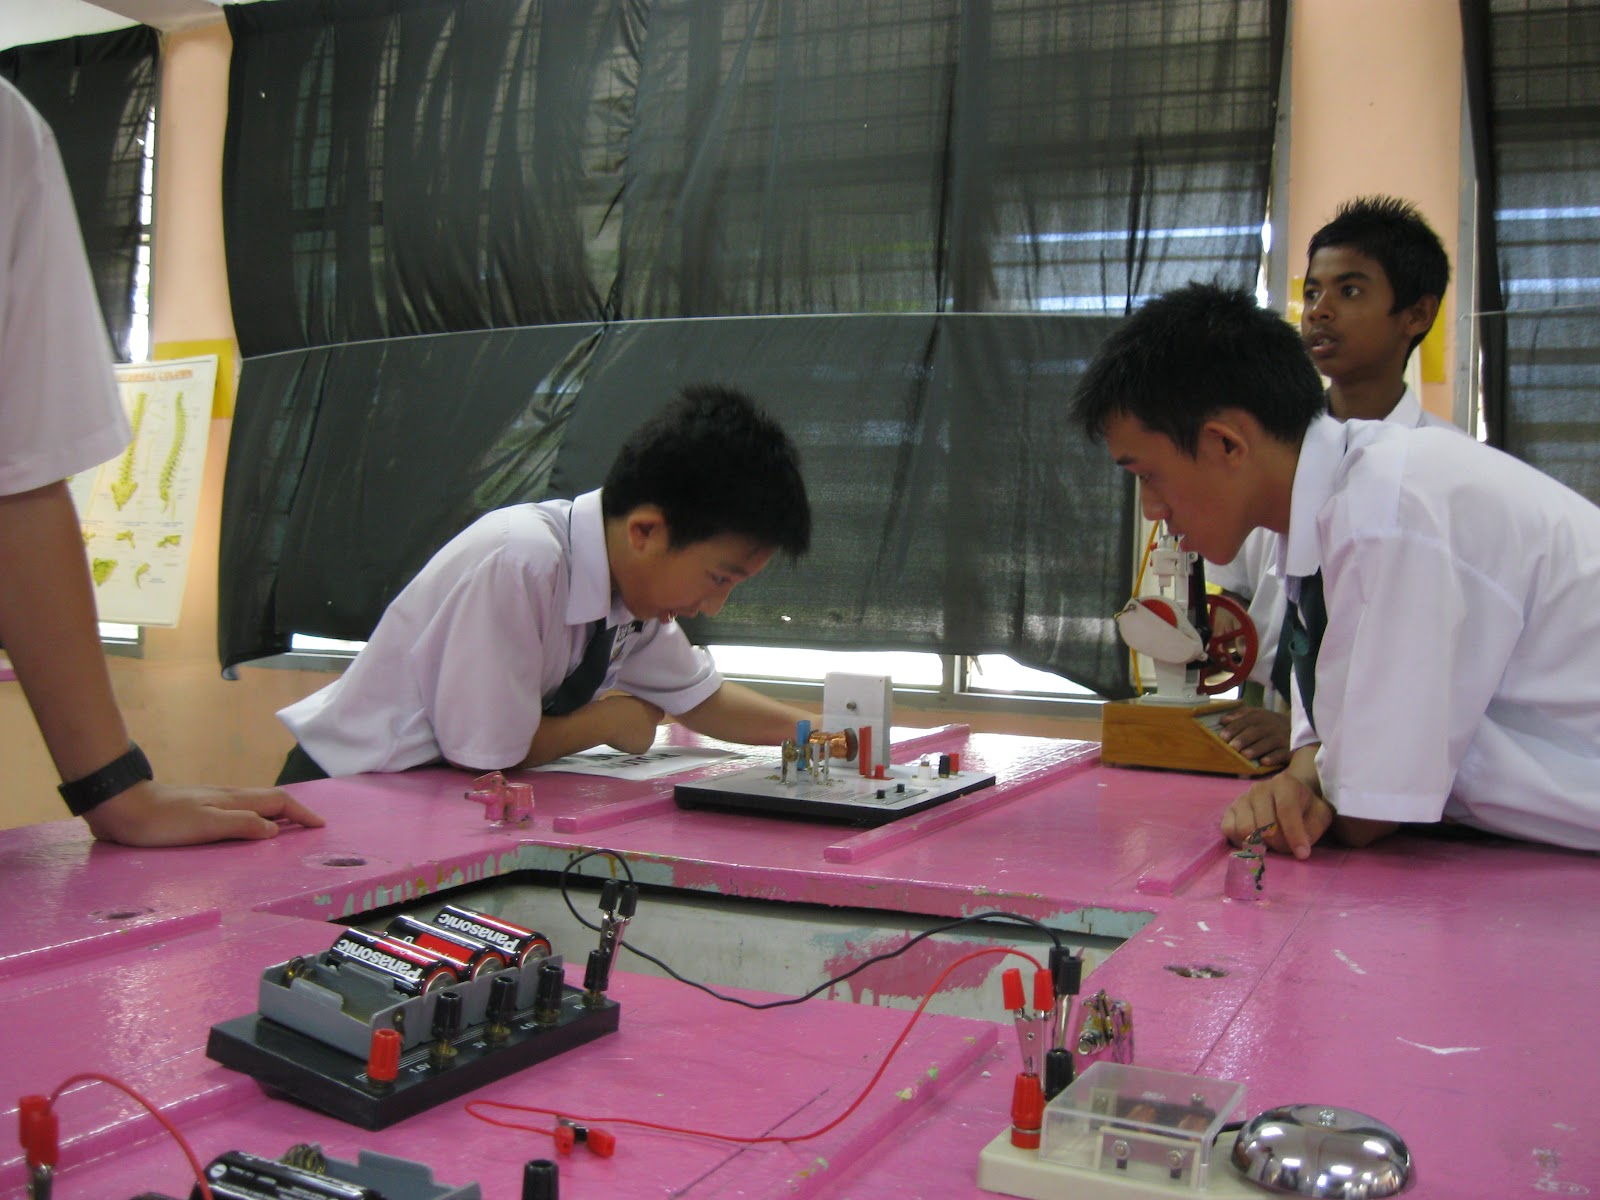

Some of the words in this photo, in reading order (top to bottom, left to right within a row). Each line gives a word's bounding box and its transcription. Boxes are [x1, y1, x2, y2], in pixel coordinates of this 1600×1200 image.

[438, 912, 520, 952] Panasonic
[337, 938, 423, 981] Panasonic
[409, 1062, 431, 1074] 1.5V
